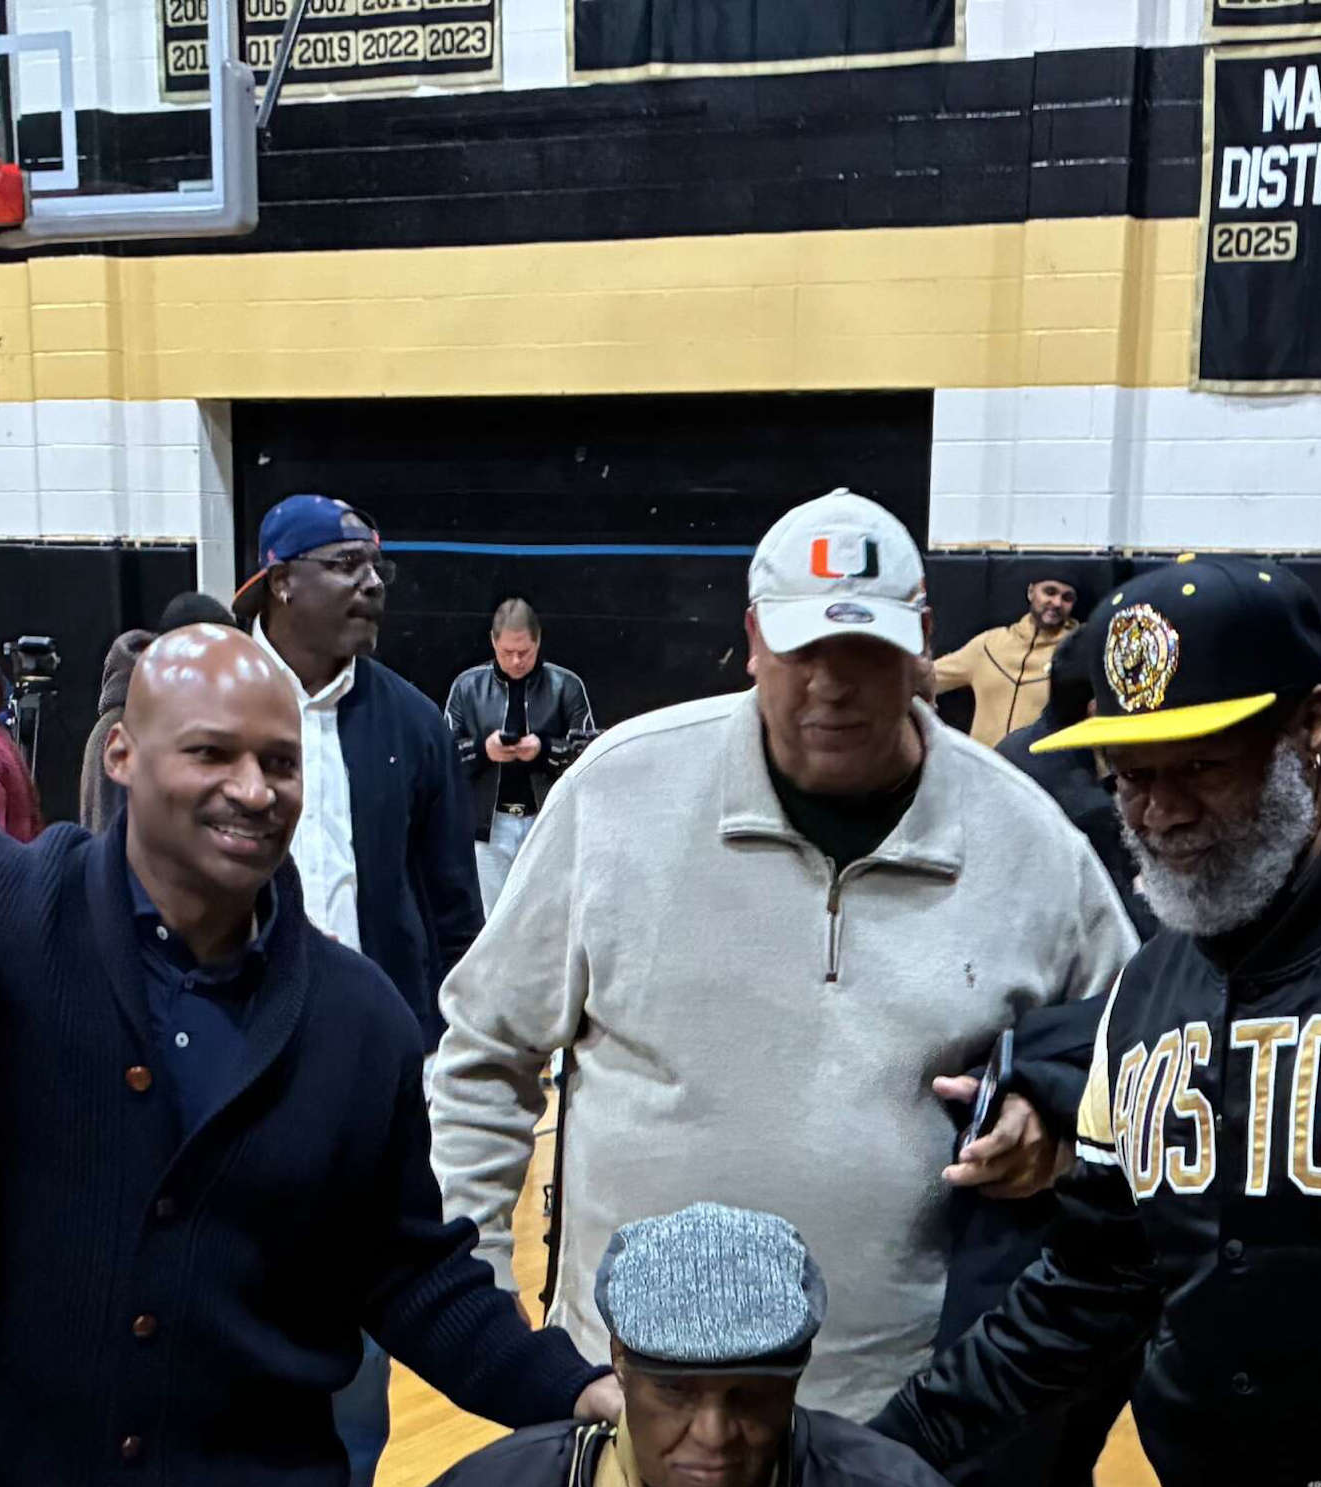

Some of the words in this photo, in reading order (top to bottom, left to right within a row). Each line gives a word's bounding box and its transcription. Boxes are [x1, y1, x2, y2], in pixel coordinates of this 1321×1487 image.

[172, 45, 208, 71] 201
[299, 36, 350, 64] 2019
[362, 31, 419, 60] 2022
[430, 26, 486, 56] 2023
[1216, 226, 1292, 259] 2025
